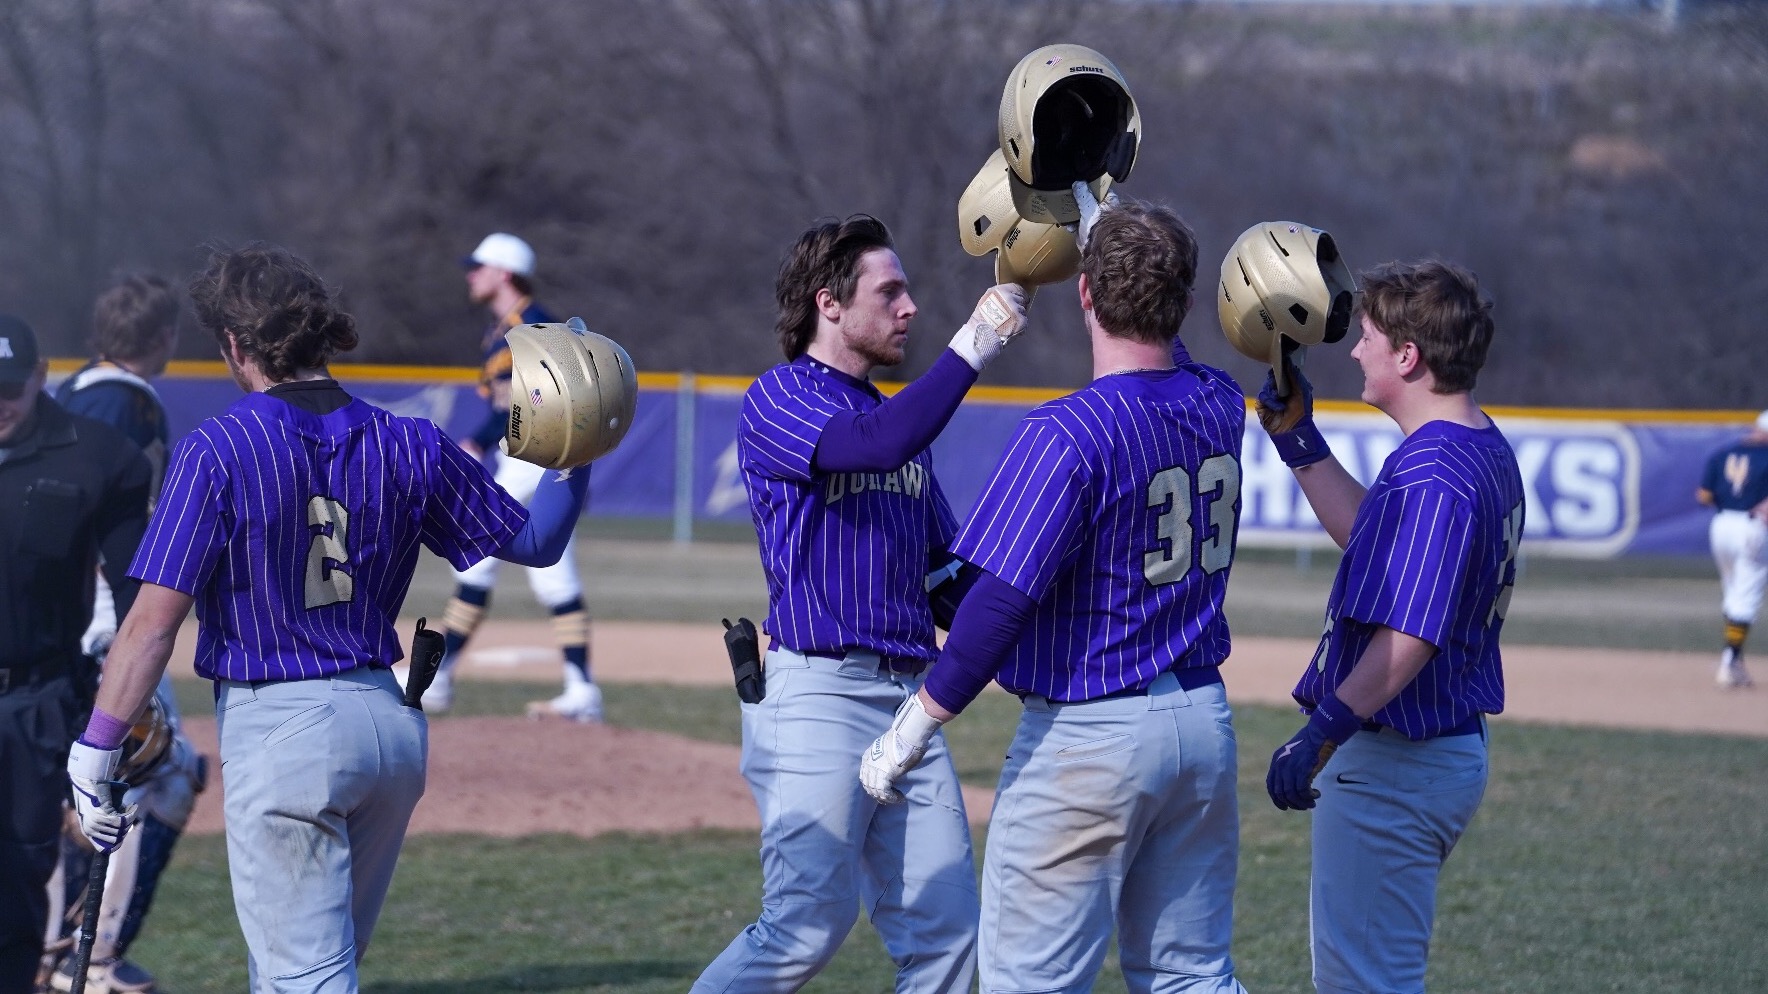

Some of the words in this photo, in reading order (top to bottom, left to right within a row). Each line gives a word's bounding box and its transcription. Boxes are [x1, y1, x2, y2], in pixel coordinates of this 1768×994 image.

[1069, 65, 1104, 73] schutt
[512, 403, 522, 440] schutt
[304, 494, 353, 611] 2
[1143, 452, 1240, 587] 33
